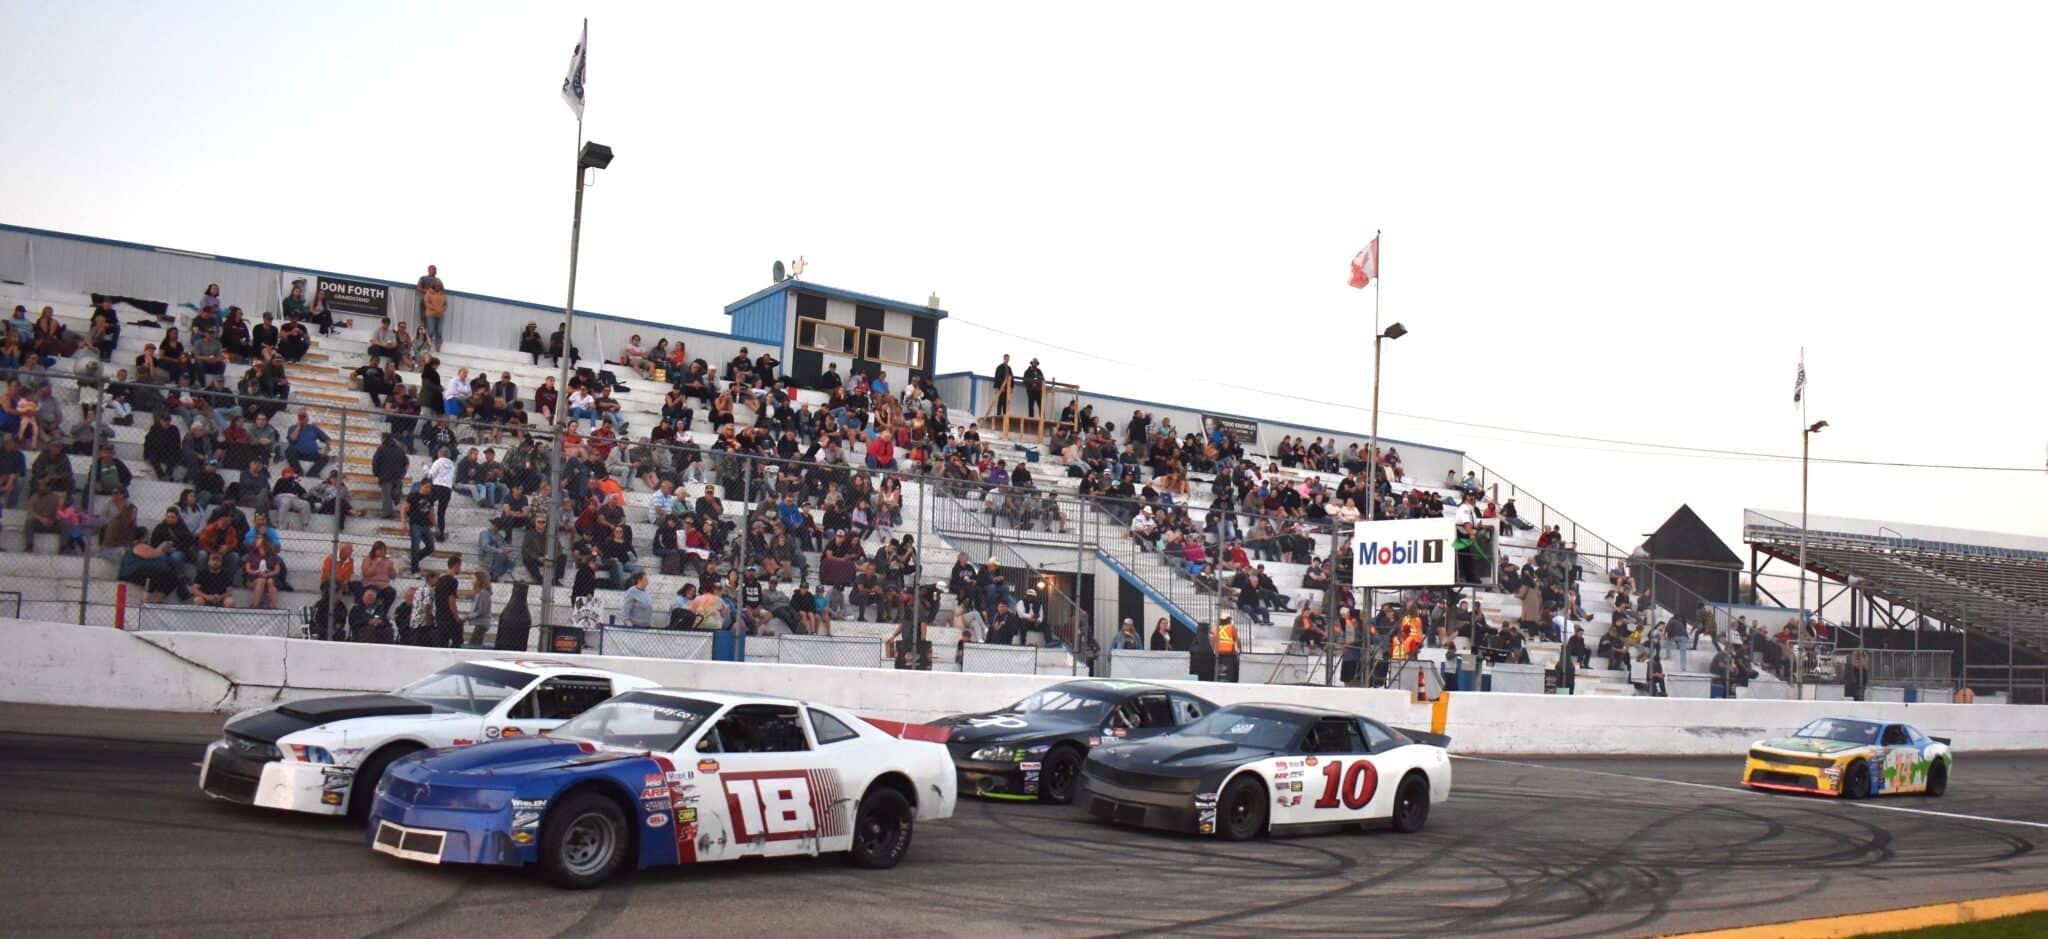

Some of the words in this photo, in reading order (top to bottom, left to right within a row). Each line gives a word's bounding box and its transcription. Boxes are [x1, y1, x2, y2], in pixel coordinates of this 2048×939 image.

[320, 281, 346, 293] DON
[347, 285, 385, 299] FORTH
[1359, 540, 1418, 565] Mobil
[641, 787, 670, 798] ARP
[1314, 759, 1378, 810] 10
[724, 778, 815, 837] 18
